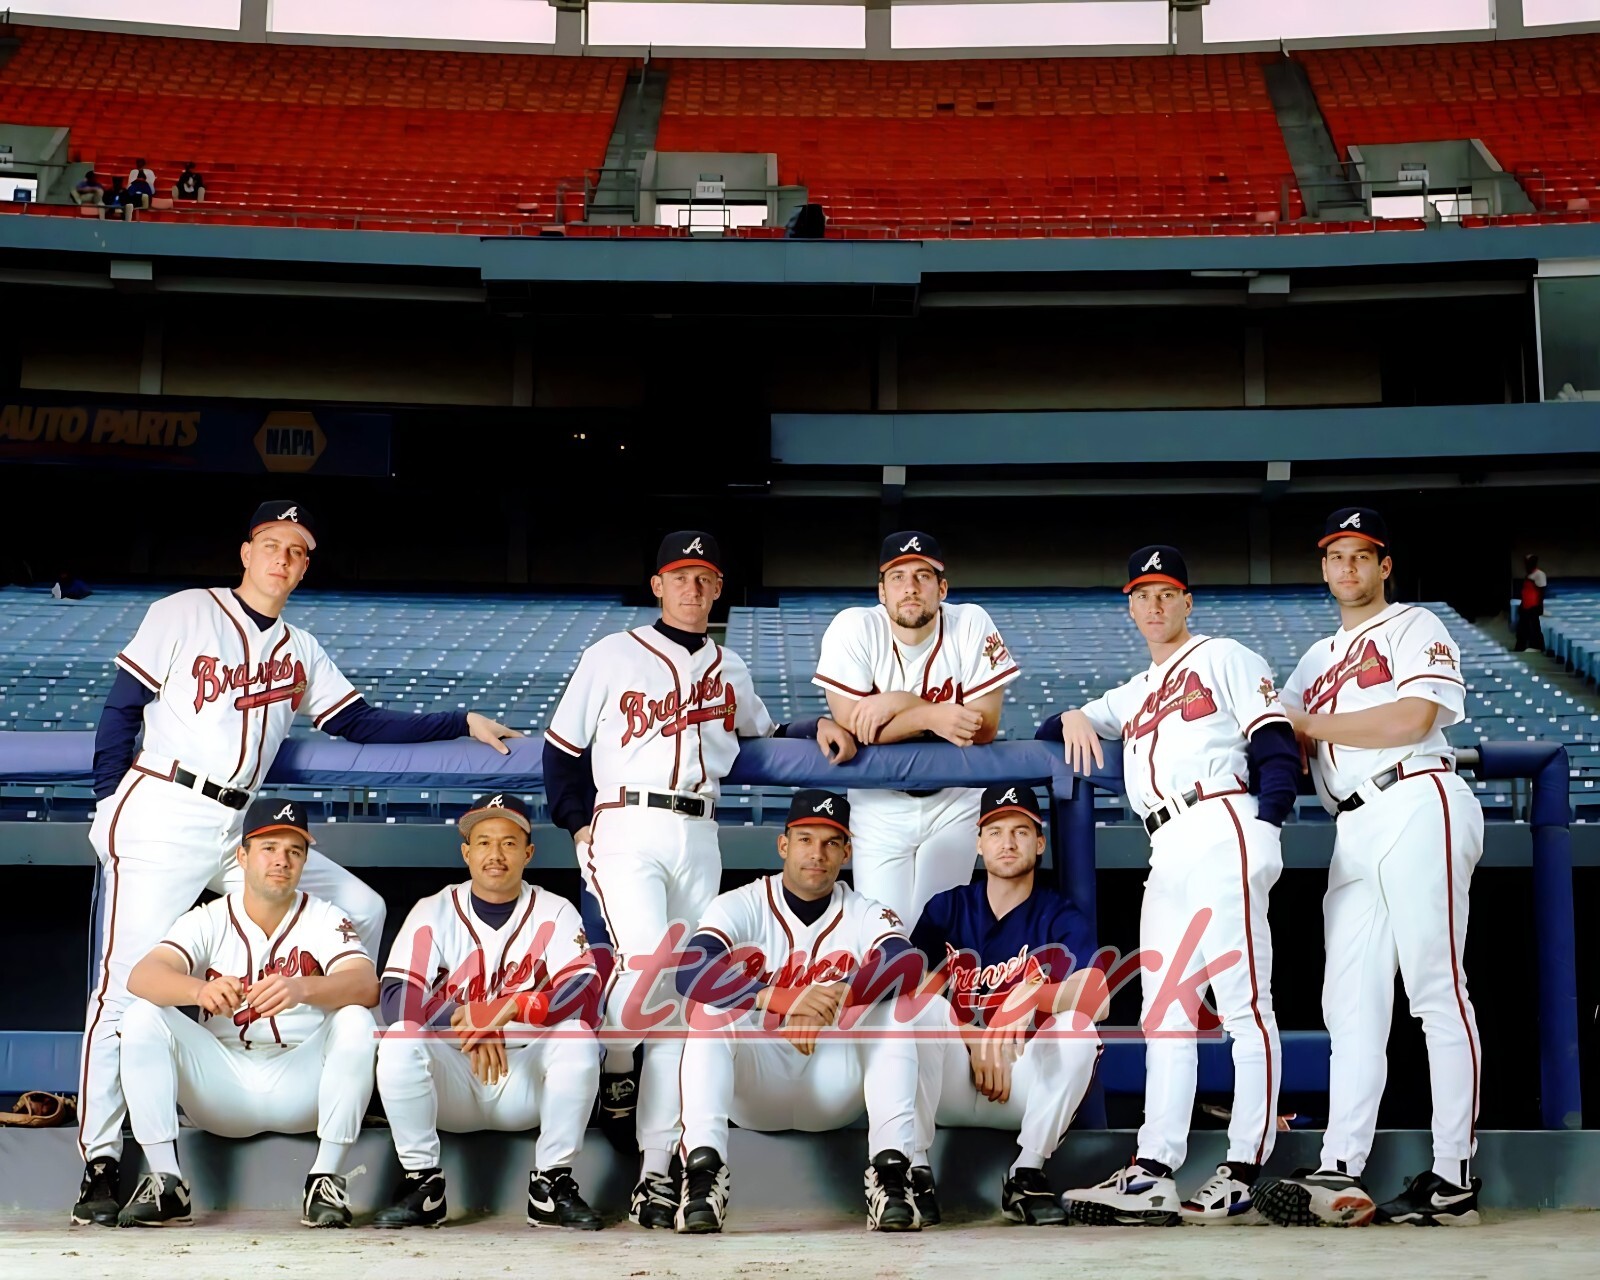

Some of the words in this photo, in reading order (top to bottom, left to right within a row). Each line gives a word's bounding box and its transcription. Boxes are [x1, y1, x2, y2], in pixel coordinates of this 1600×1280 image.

[1, 404, 89, 443] AUTO
[92, 410, 200, 446] PARTS
[265, 428, 315, 456] NAPA
[277, 506, 300, 523] A
[1339, 513, 1361, 529] A
[683, 537, 704, 555] A
[900, 536, 922, 552] A
[1140, 551, 1162, 572] A
[192, 653, 293, 714] Braves
[620, 671, 723, 748] Braves
[484, 794, 504, 809] A
[813, 797, 834, 817] A
[994, 787, 1016, 807] A
[272, 803, 295, 822] A
